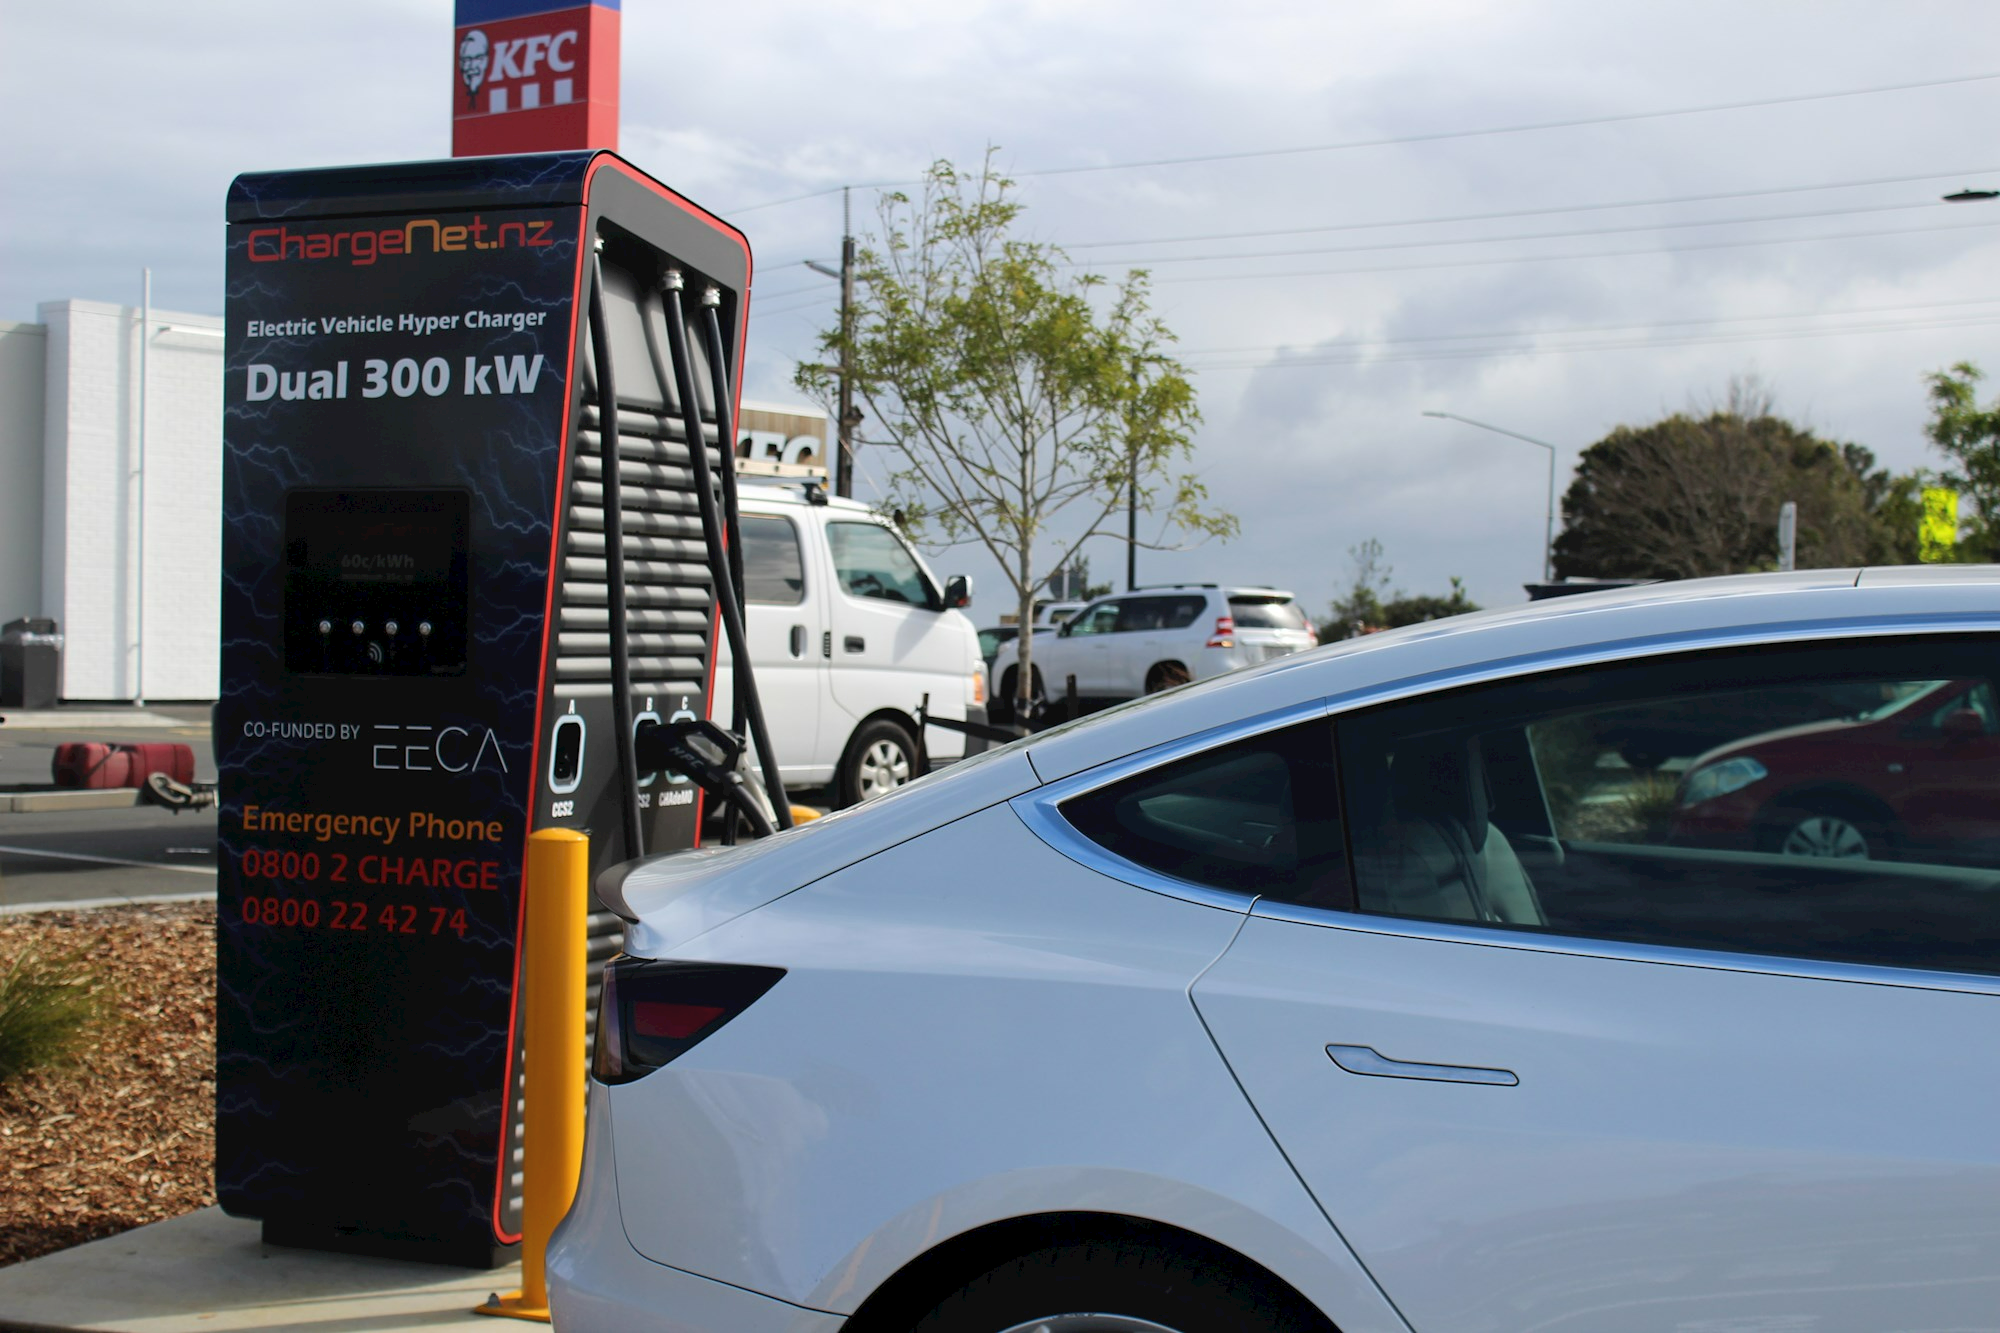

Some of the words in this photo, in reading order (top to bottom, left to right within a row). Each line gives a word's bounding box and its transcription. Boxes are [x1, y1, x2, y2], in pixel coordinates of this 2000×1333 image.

[488, 30, 578, 82] KFC
[247, 214, 554, 266] ChargeNet.nz
[246, 317, 317, 338] Electric
[320, 315, 394, 335] Vehicle
[398, 313, 460, 336] Hyper
[464, 310, 547, 333] Charger
[246, 360, 348, 402] Dual
[361, 356, 451, 399] 300
[463, 354, 545, 396] kW
[736, 429, 821, 465] FC
[340, 553, 415, 571] 60c/kWh
[568, 699, 575, 714] A
[645, 697, 653, 712] B
[681, 695, 689, 711] C
[243, 720, 336, 740] CO-FUNDED
[339, 724, 361, 740] BY
[373, 725, 509, 773] EECA
[242, 804, 401, 845] Emergency
[408, 811, 504, 842] Phone
[551, 800, 575, 818] CCS2
[241, 849, 321, 881] 0800
[329, 853, 348, 882] 2
[357, 855, 500, 890] CHARGE
[241, 896, 321, 928] 0800
[329, 900, 369, 931] 22
[377, 904, 418, 934] 42
[427, 906, 469, 938] 74
